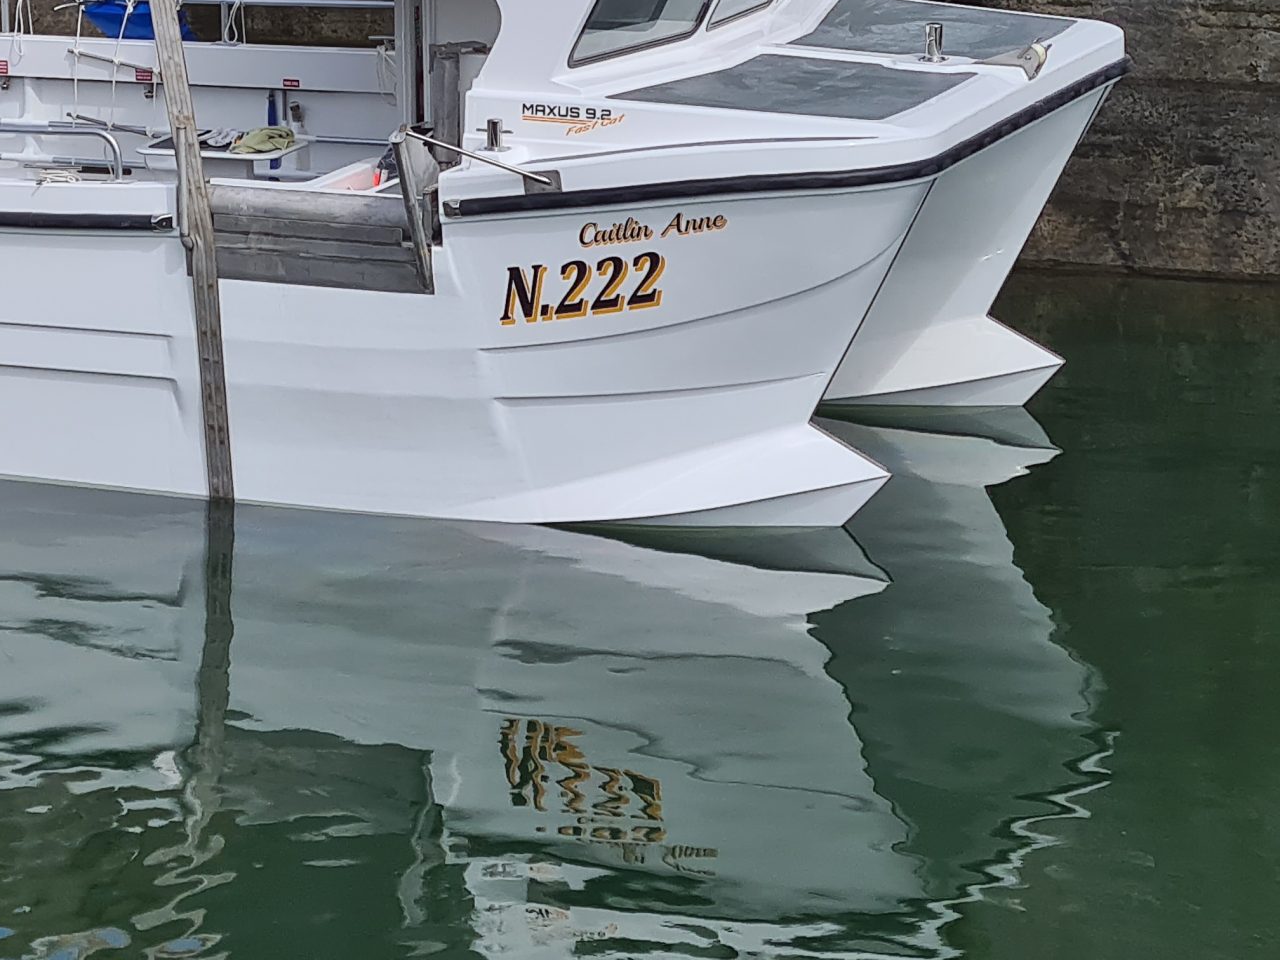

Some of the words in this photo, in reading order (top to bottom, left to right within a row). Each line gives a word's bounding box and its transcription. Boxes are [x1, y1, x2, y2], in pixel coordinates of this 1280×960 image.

[522, 103, 580, 119] MAXUS
[585, 108, 612, 121] 9.2
[565, 120, 598, 137] Fast
[579, 217, 654, 247] Caitlin
[660, 212, 728, 238] Anne
[500, 251, 666, 326] N.222
